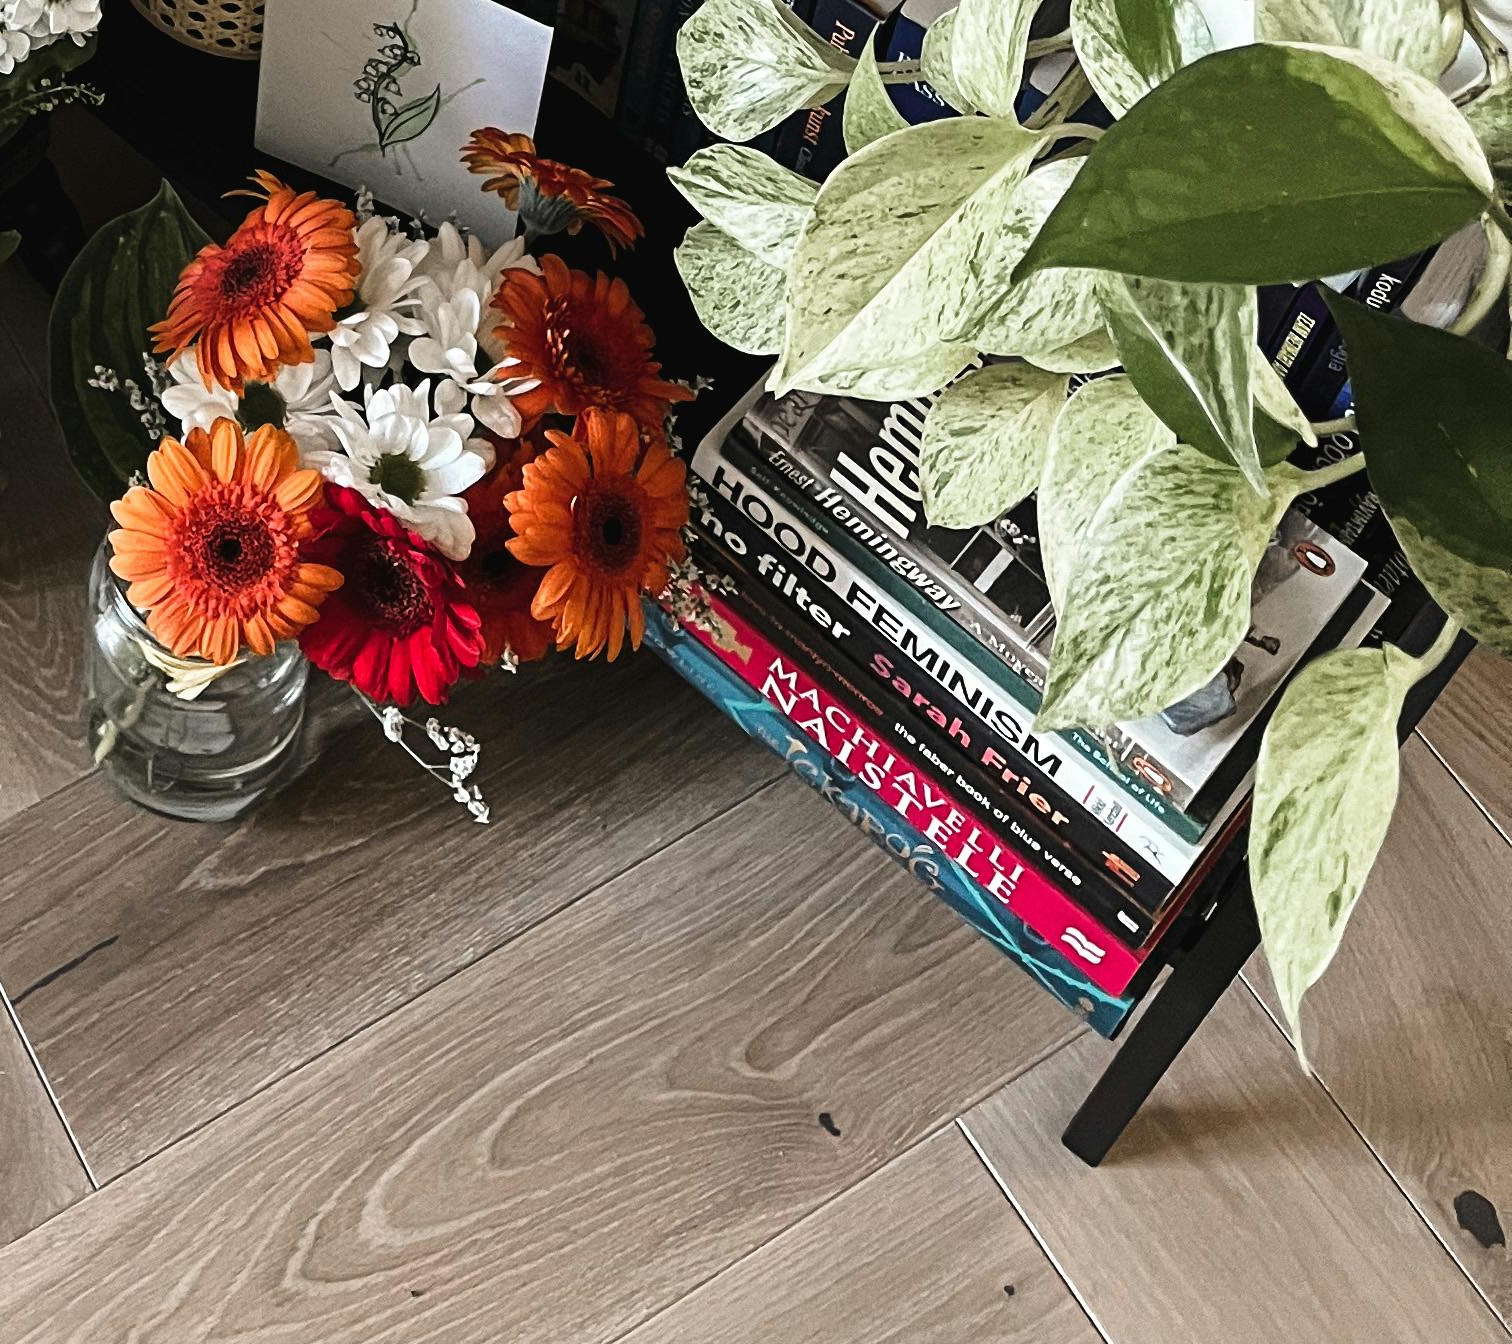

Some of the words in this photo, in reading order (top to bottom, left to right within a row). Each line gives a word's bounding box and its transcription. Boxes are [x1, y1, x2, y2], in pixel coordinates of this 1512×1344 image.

[1366, 272, 1402, 310] kodu
[712, 465, 837, 584] HOOD
[846, 581, 1063, 778] FEMINISM
[769, 450, 817, 490] Ernest
[814, 487, 962, 611] Hemingway
[699, 513, 747, 556] no
[757, 553, 851, 639] filter
[870, 653, 971, 749] Sarah
[980, 746, 1070, 828] Frier
[759, 674, 1016, 904] NAISTELE
[768, 657, 1025, 885] MACHIAVELLI
[894, 722, 916, 746] the
[919, 742, 954, 777] faber
[955, 774, 991, 810] book
[993, 808, 1009, 824] of
[1010, 821, 1041, 852] blue
[1043, 850, 1082, 887] verse
[1071, 731, 1092, 751] The
[1092, 750, 1130, 785] Schol
[1131, 782, 1145, 796] of
[1143, 795, 1165, 814] Life
